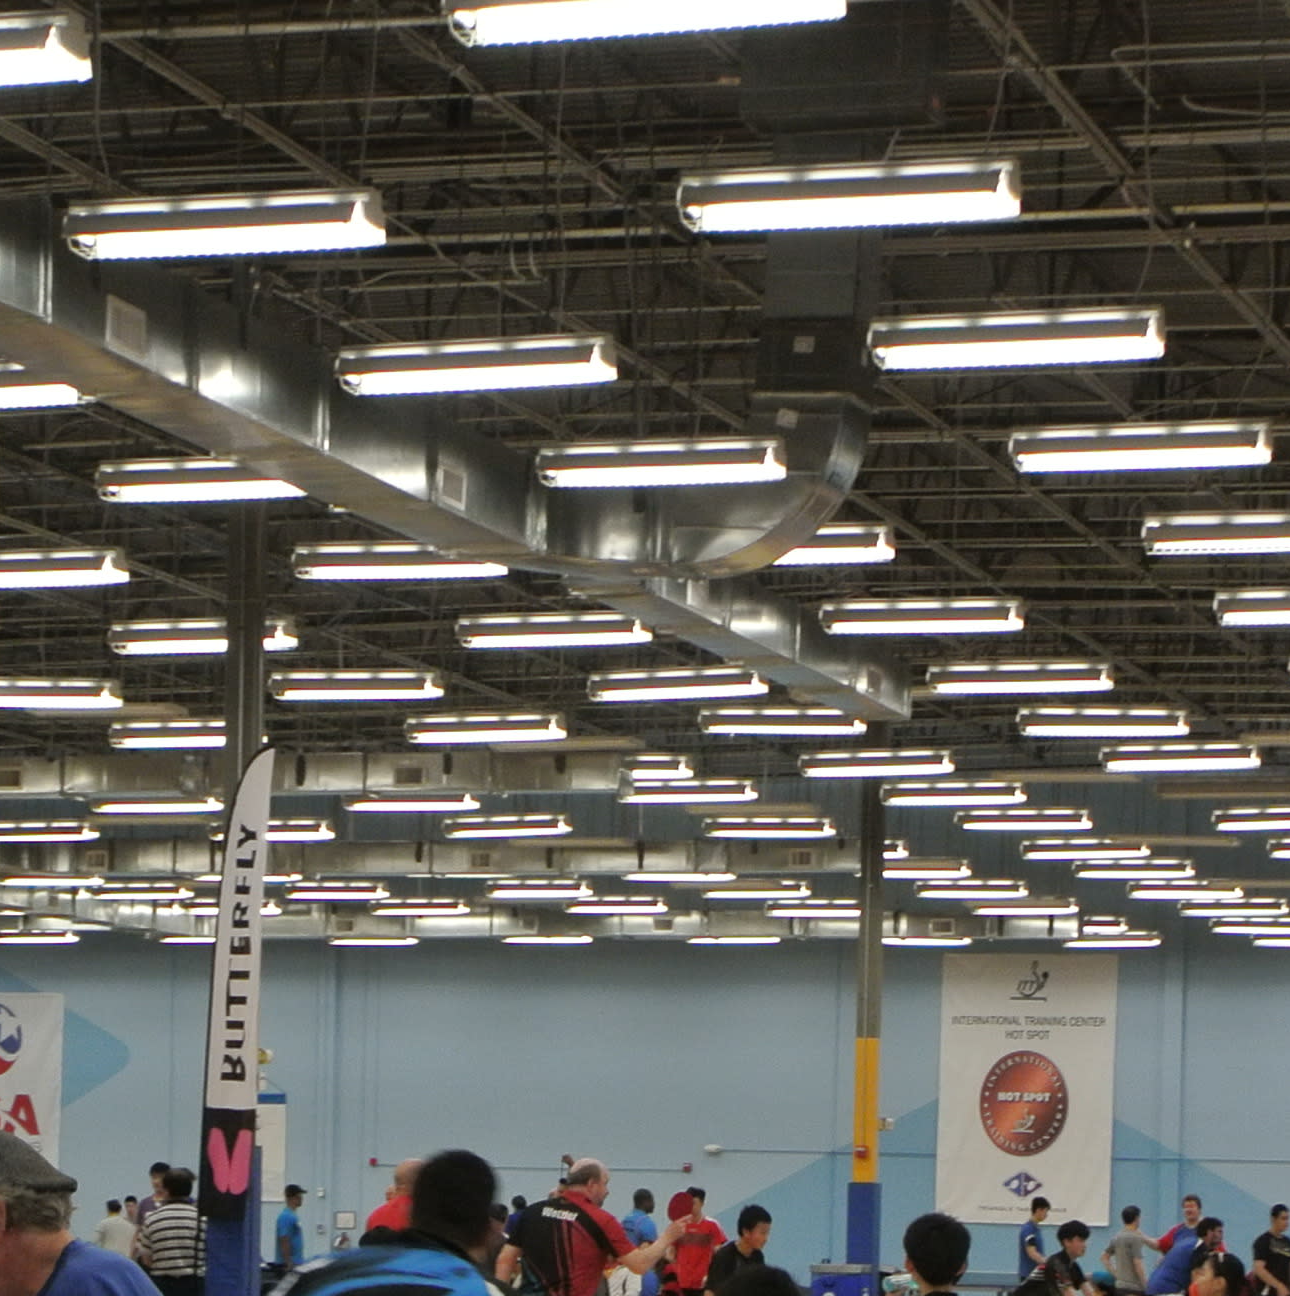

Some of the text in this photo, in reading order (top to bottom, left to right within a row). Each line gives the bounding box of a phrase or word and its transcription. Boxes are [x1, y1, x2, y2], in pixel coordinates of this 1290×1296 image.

[220, 824, 258, 1083] BUTTERFLY
[951, 1015, 1107, 1027] INTERNATIONAL TRAINING CENTER
[1005, 1030, 1050, 1040] HOT SPOT
[997, 1092, 1051, 1103] HOT SPOT
